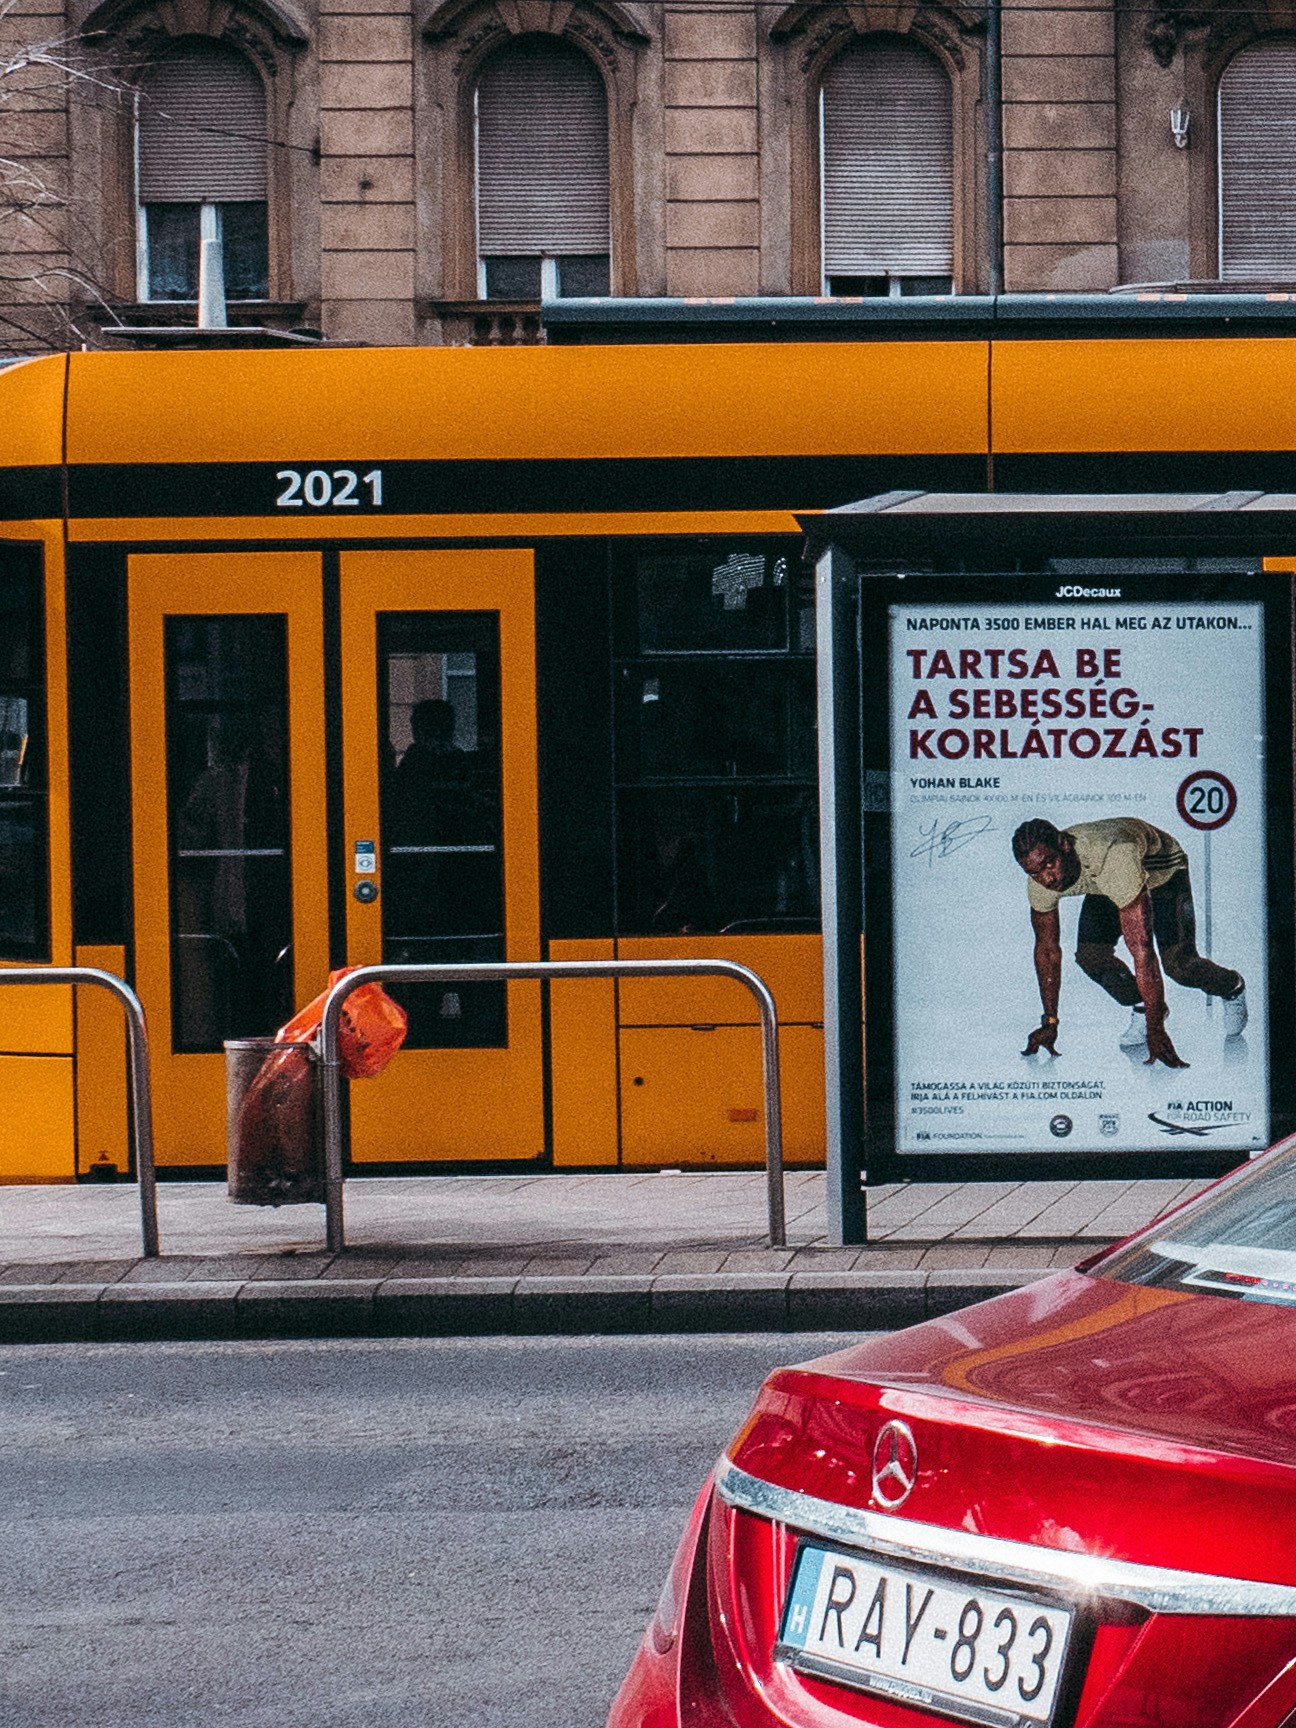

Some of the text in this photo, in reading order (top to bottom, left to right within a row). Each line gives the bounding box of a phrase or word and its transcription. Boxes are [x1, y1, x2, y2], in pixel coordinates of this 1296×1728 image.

[276, 469, 382, 507] 2021
[1055, 585, 1121, 598] JCDecaux
[906, 616, 1252, 631] NAPONTA 3500 EMBER HAL MEG AZ UTAKON...
[906, 648, 1121, 680] TARTSA BE
[907, 678, 1154, 720] A SEBESSÉG-
[907, 716, 1204, 760] KORLÁTOZÁST
[910, 777, 1000, 789] YOHAN BLAKE
[1189, 786, 1224, 814] 20
[952, 1092, 959, 1100] A
[1012, 1092, 1019, 1100] A
[1059, 1091, 1103, 1100] OLDALON
[969, 1082, 976, 1090] A
[1167, 1100, 1233, 1112] FIA ACTION
[1183, 1112, 1211, 1123] ROAD
[1213, 1111, 1252, 1123] SAFETY
[789, 1605, 808, 1635] H
[819, 1565, 1054, 1703] RAY-833
